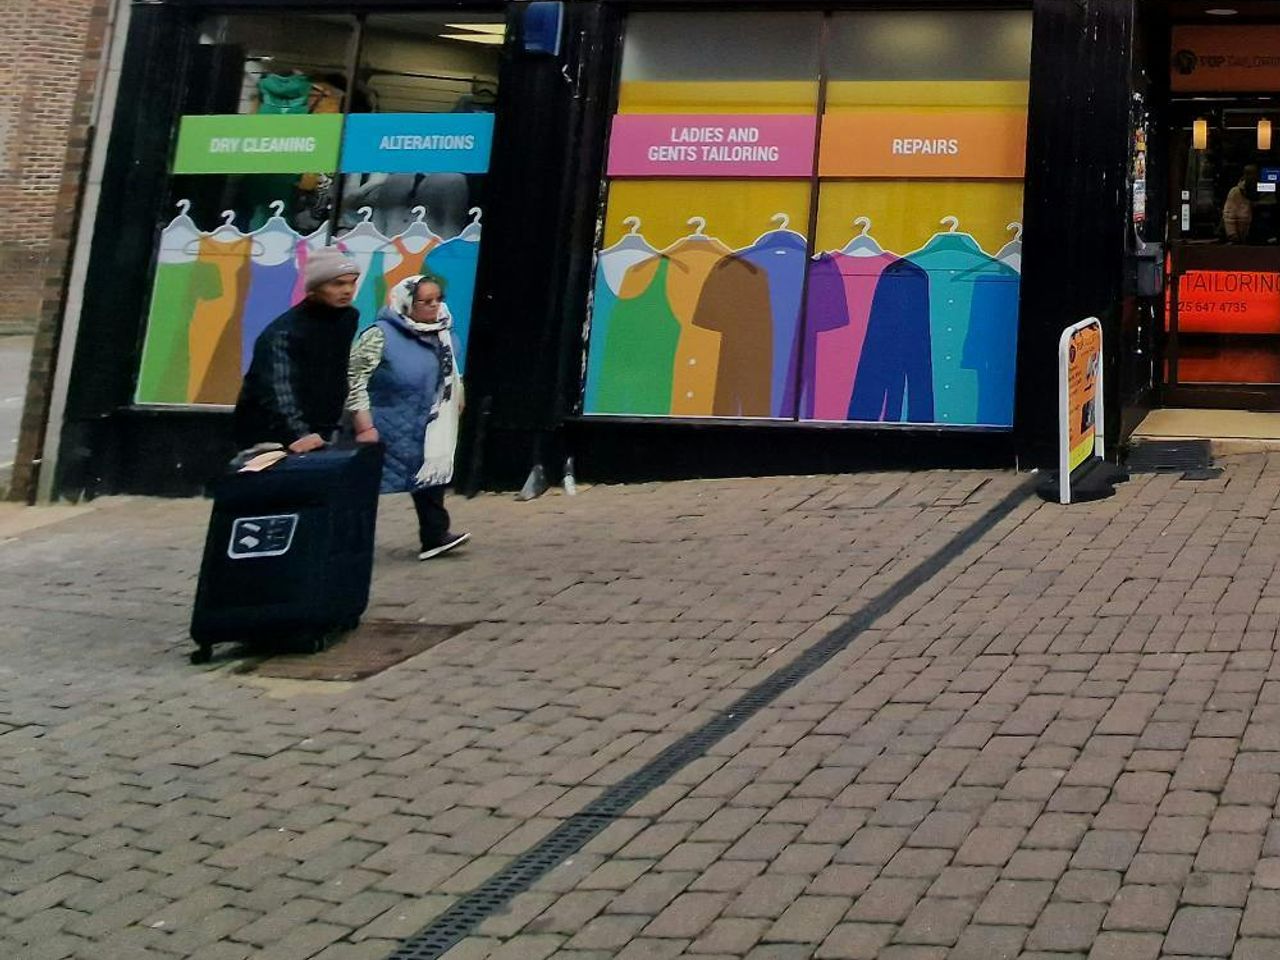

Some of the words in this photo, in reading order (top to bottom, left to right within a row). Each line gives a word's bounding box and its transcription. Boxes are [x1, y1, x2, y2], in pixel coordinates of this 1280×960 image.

[671, 128, 722, 142] LADIES
[727, 127, 759, 142] AND
[209, 138, 241, 153] DRY
[243, 137, 316, 153] CLEANING
[379, 135, 475, 150] ALTERATIONS
[892, 139, 958, 155] REPAIRS
[648, 146, 697, 161] GENTS
[701, 146, 779, 161] TAILORING
[1219, 302, 1247, 312] 4735
